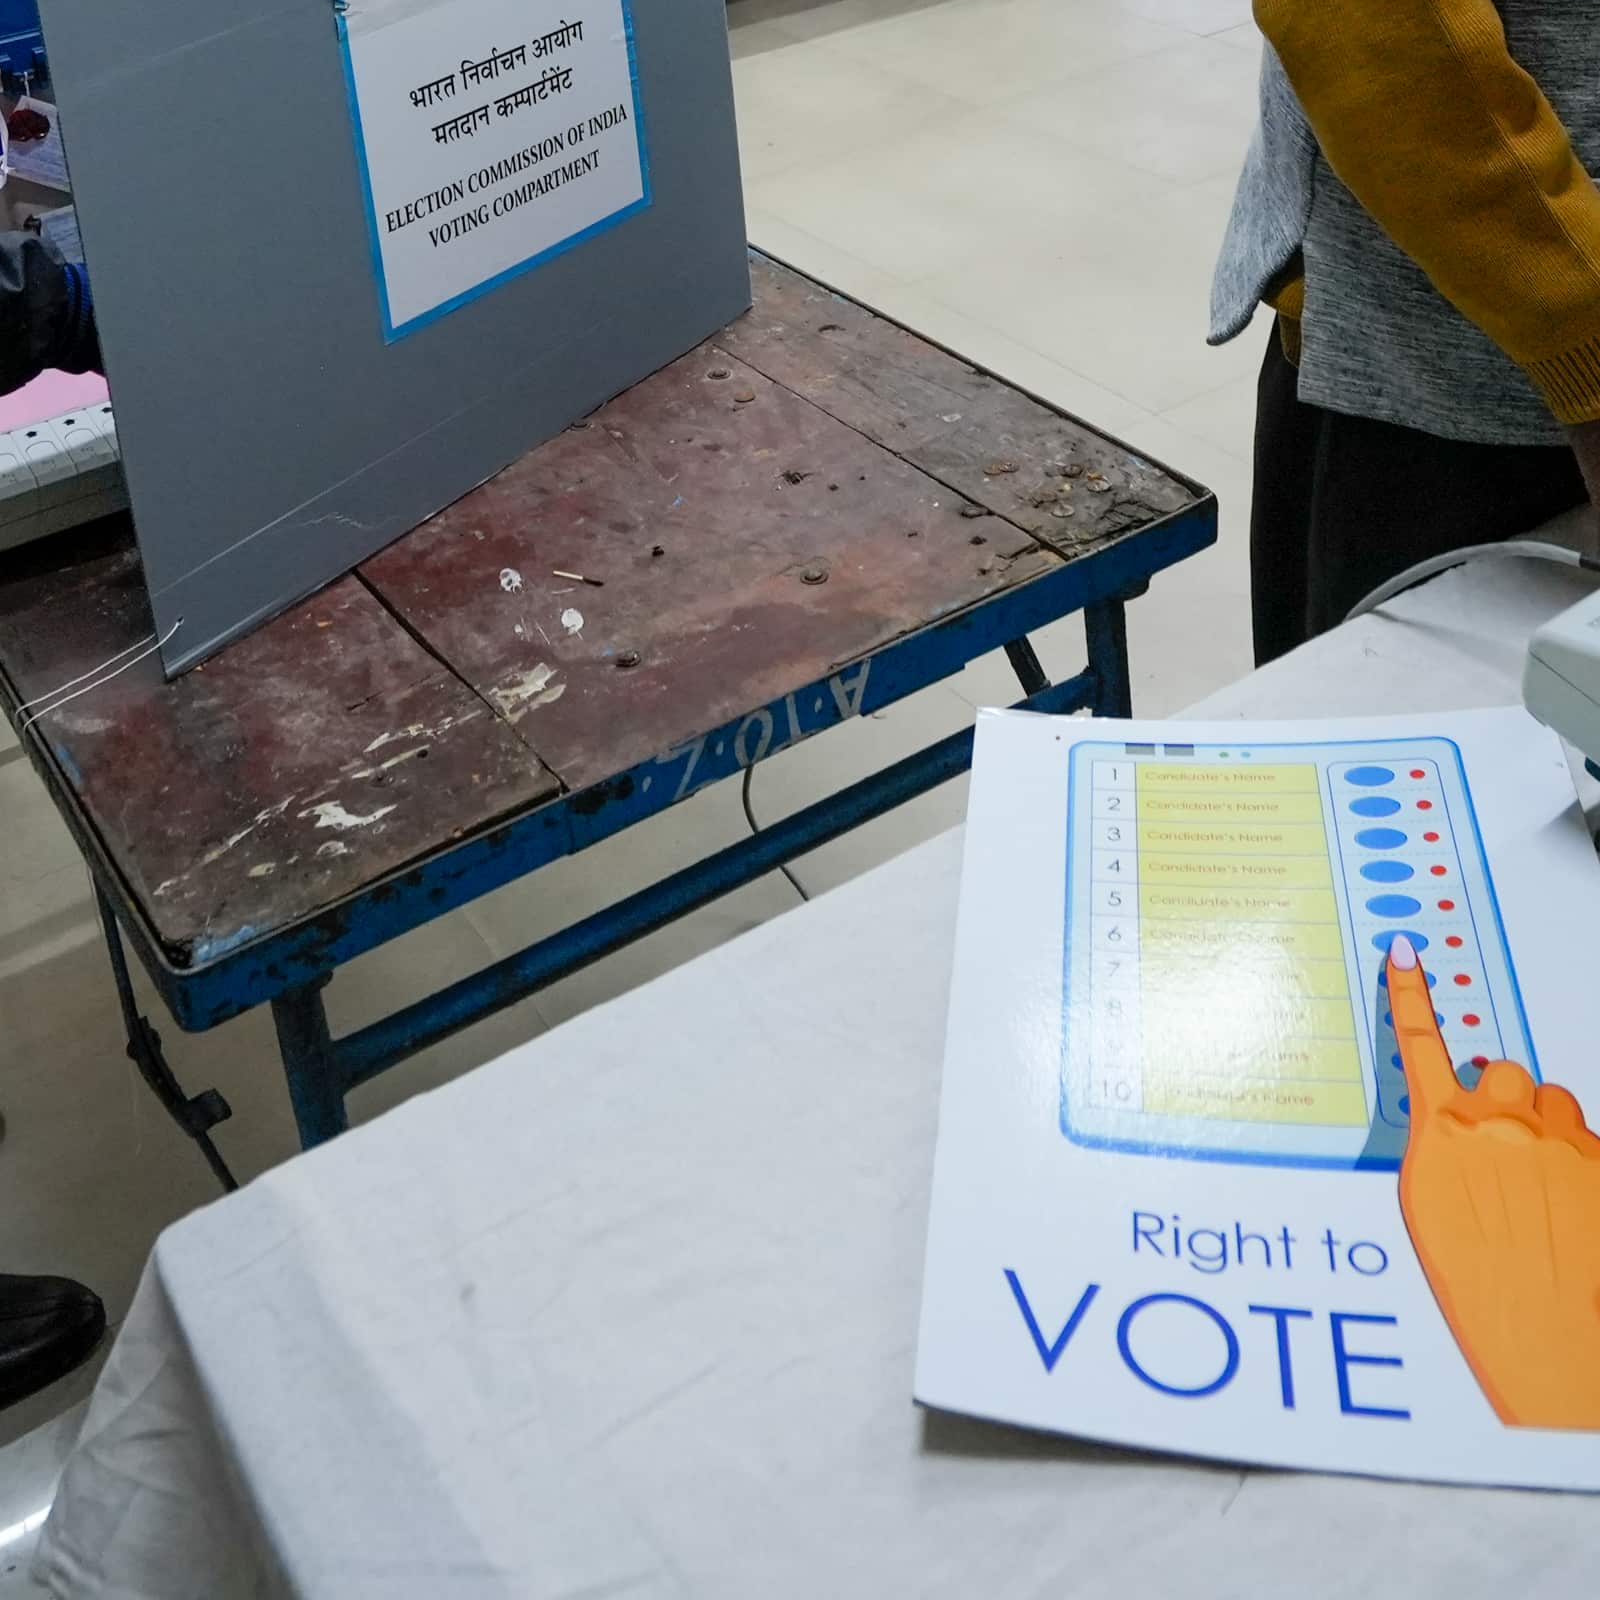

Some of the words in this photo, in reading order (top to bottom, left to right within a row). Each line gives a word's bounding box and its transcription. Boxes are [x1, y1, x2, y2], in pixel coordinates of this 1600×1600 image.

[409, 74, 456, 109] भारत
[460, 47, 527, 90] निर्वाचन
[532, 20, 584, 59] आयोग
[431, 105, 491, 145] मतदान
[494, 65, 574, 119] कम्पार्टमेंट
[385, 180, 465, 234] ELECTION
[467, 132, 565, 194] COMMISSION
[567, 123, 586, 146] OF
[589, 103, 628, 137] INDIA
[428, 204, 490, 248] VOTING
[492, 149, 601, 218] COMPARTMENT
[1110, 767, 1118, 782] 1
[1106, 797, 1122, 811] 2
[1106, 827, 1122, 842] 3
[1106, 859, 1122, 874] 4
[1107, 891, 1122, 907] 5
[1107, 926, 1122, 942] 6
[1106, 961, 1121, 977] 7
[1102, 1080, 1132, 1102] 10
[1132, 1211, 1296, 1274] Right
[1320, 1227, 1389, 1276] to
[1002, 1267, 1412, 1421] VOTE
